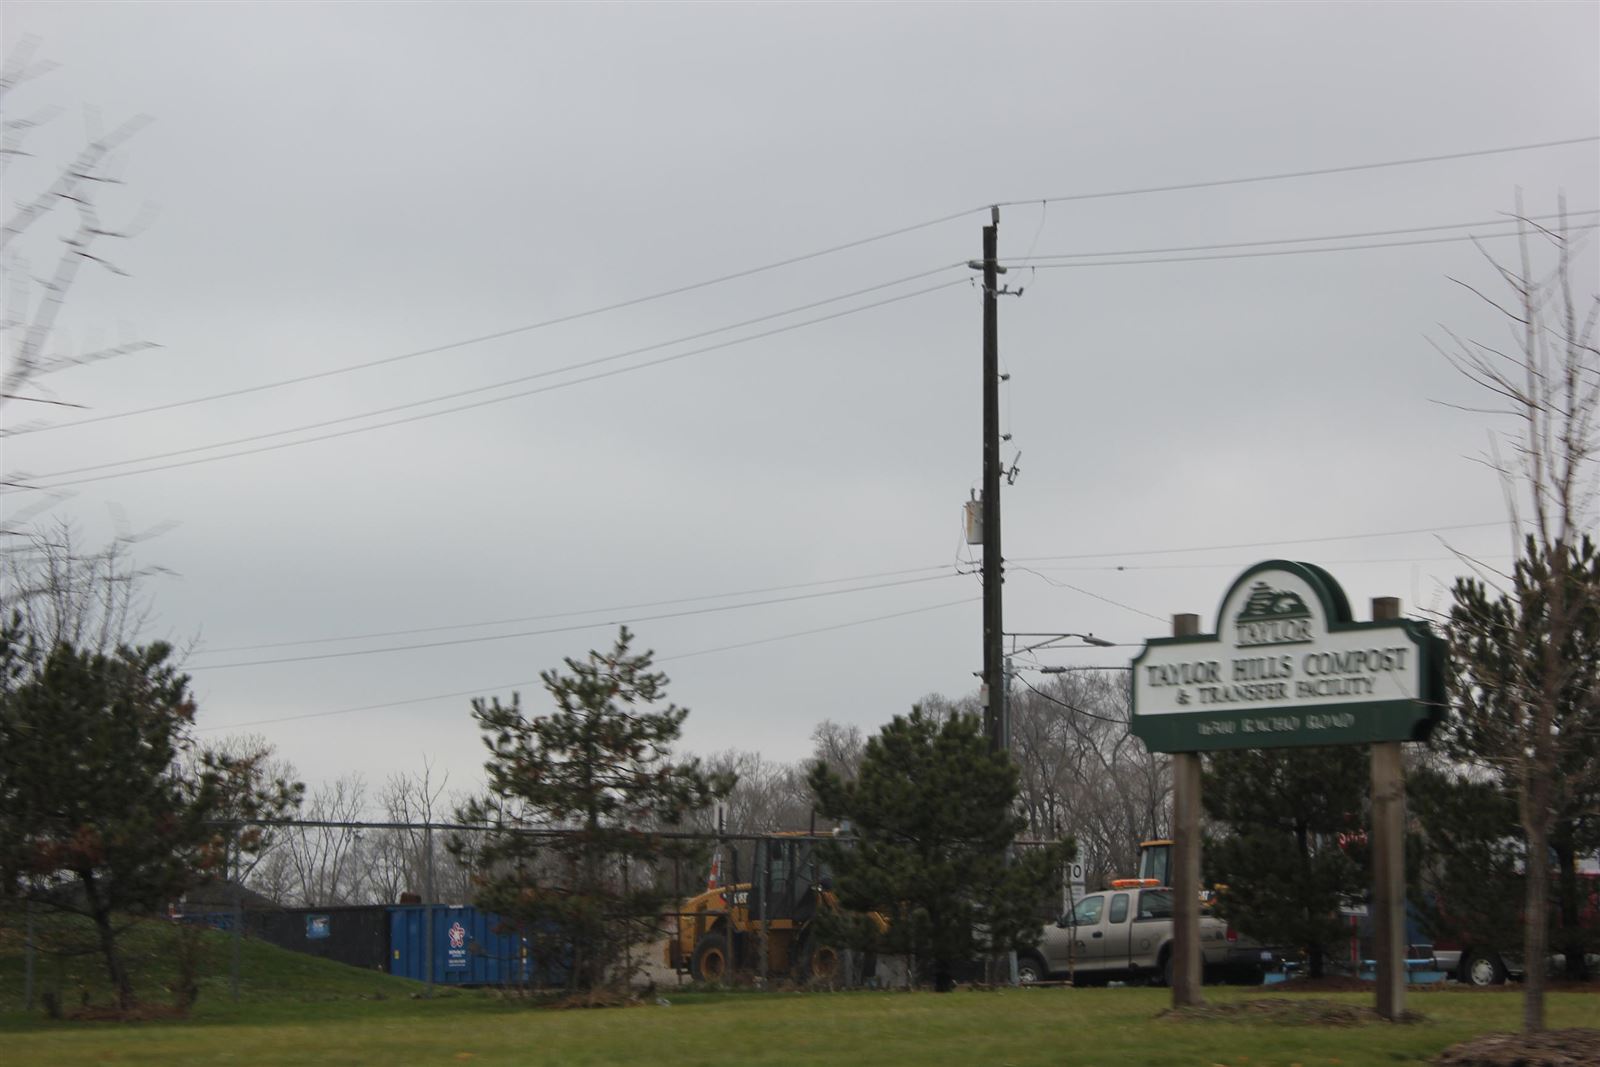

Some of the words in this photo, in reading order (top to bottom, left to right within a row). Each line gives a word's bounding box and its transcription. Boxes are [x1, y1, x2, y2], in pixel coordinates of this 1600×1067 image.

[1234, 619, 1314, 644] TAYLOR
[1145, 661, 1221, 688] TAYLOR
[1231, 655, 1294, 682] HILLS
[1302, 647, 1409, 678] COMPOST
[1175, 690, 1192, 706] &
[1199, 682, 1289, 706] TRANSFER
[1296, 676, 1377, 699] FACILITY
[1304, 712, 1355, 730] ROAD
